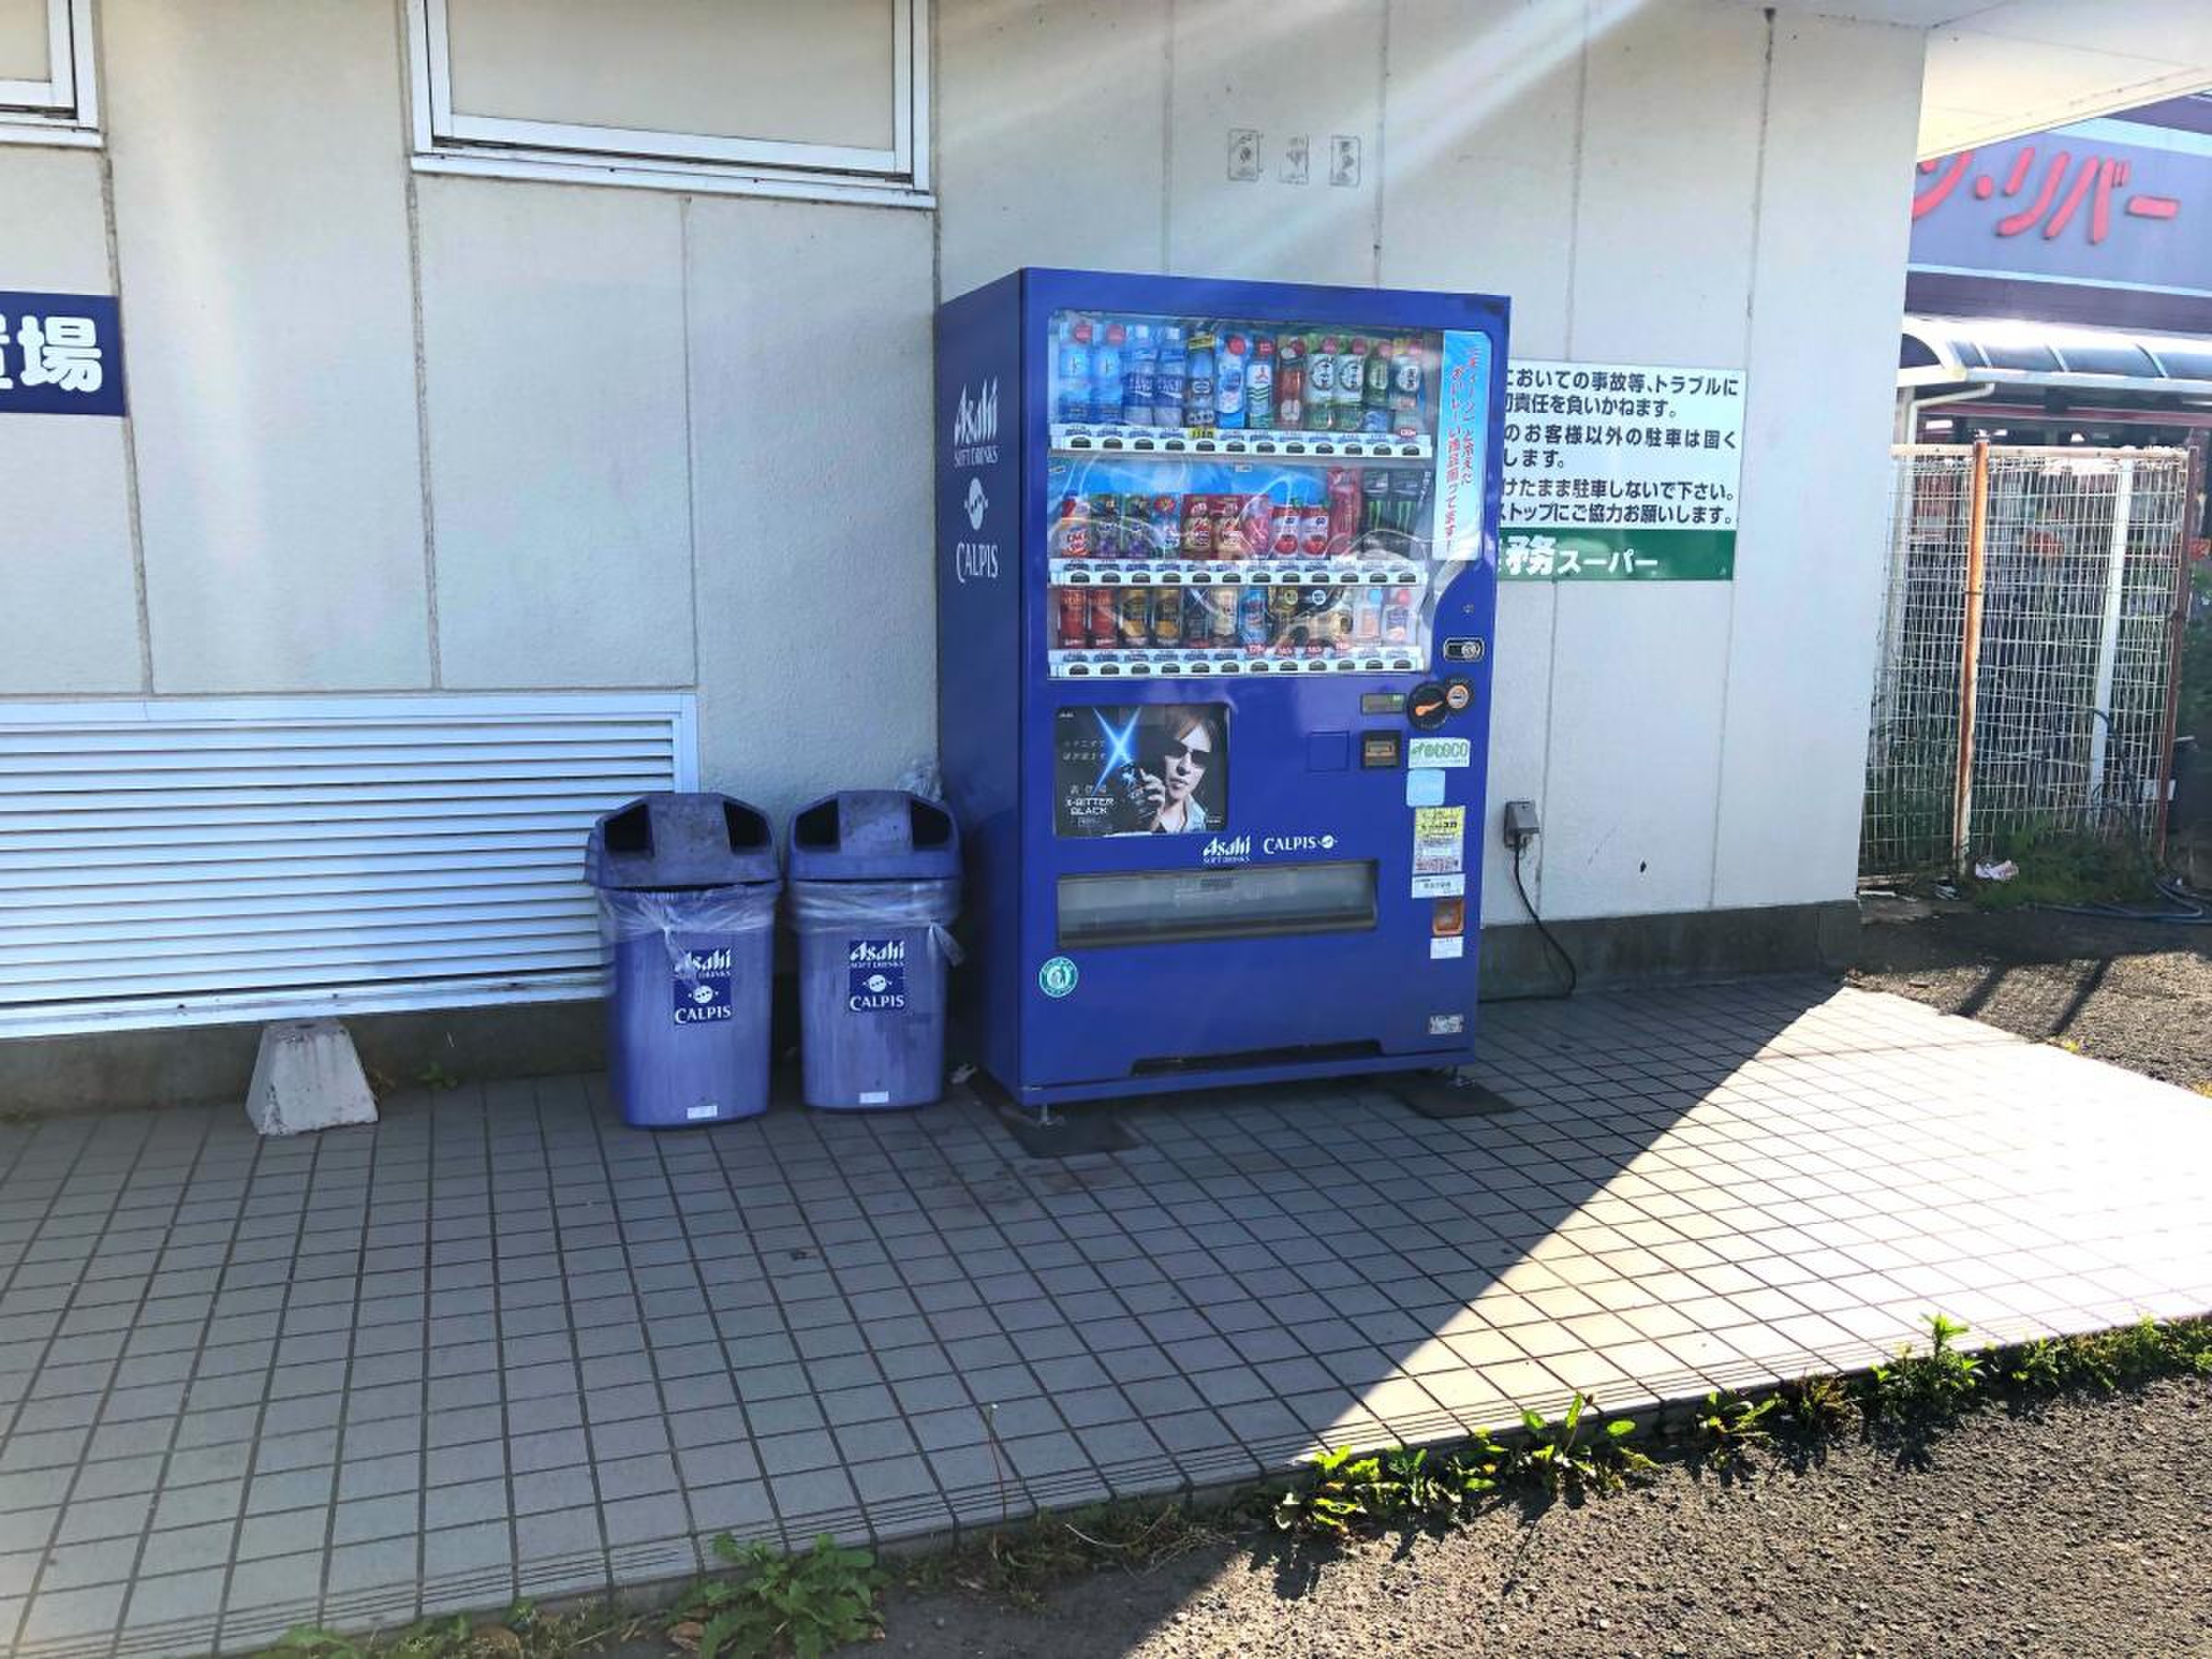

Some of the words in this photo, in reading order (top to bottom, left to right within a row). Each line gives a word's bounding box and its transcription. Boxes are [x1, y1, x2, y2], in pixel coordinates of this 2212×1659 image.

[0, 314, 102, 392] 場
[954, 375, 998, 446] Asahi
[1504, 424, 1736, 450] のお客様以外の駐車は固く
[1504, 448, 1564, 468] します。
[1500, 502, 1732, 524] トップにご協力お願いします。
[956, 543, 999, 583] CALPIS
[1499, 535, 1658, 575] 務スーパー
[1203, 834, 1251, 856] Asahi
[1264, 836, 1316, 855] CALPIS
[850, 940, 905, 960] Asahi
[850, 994, 905, 1011] CALPIS
[675, 1005, 731, 1024] CALPIS
